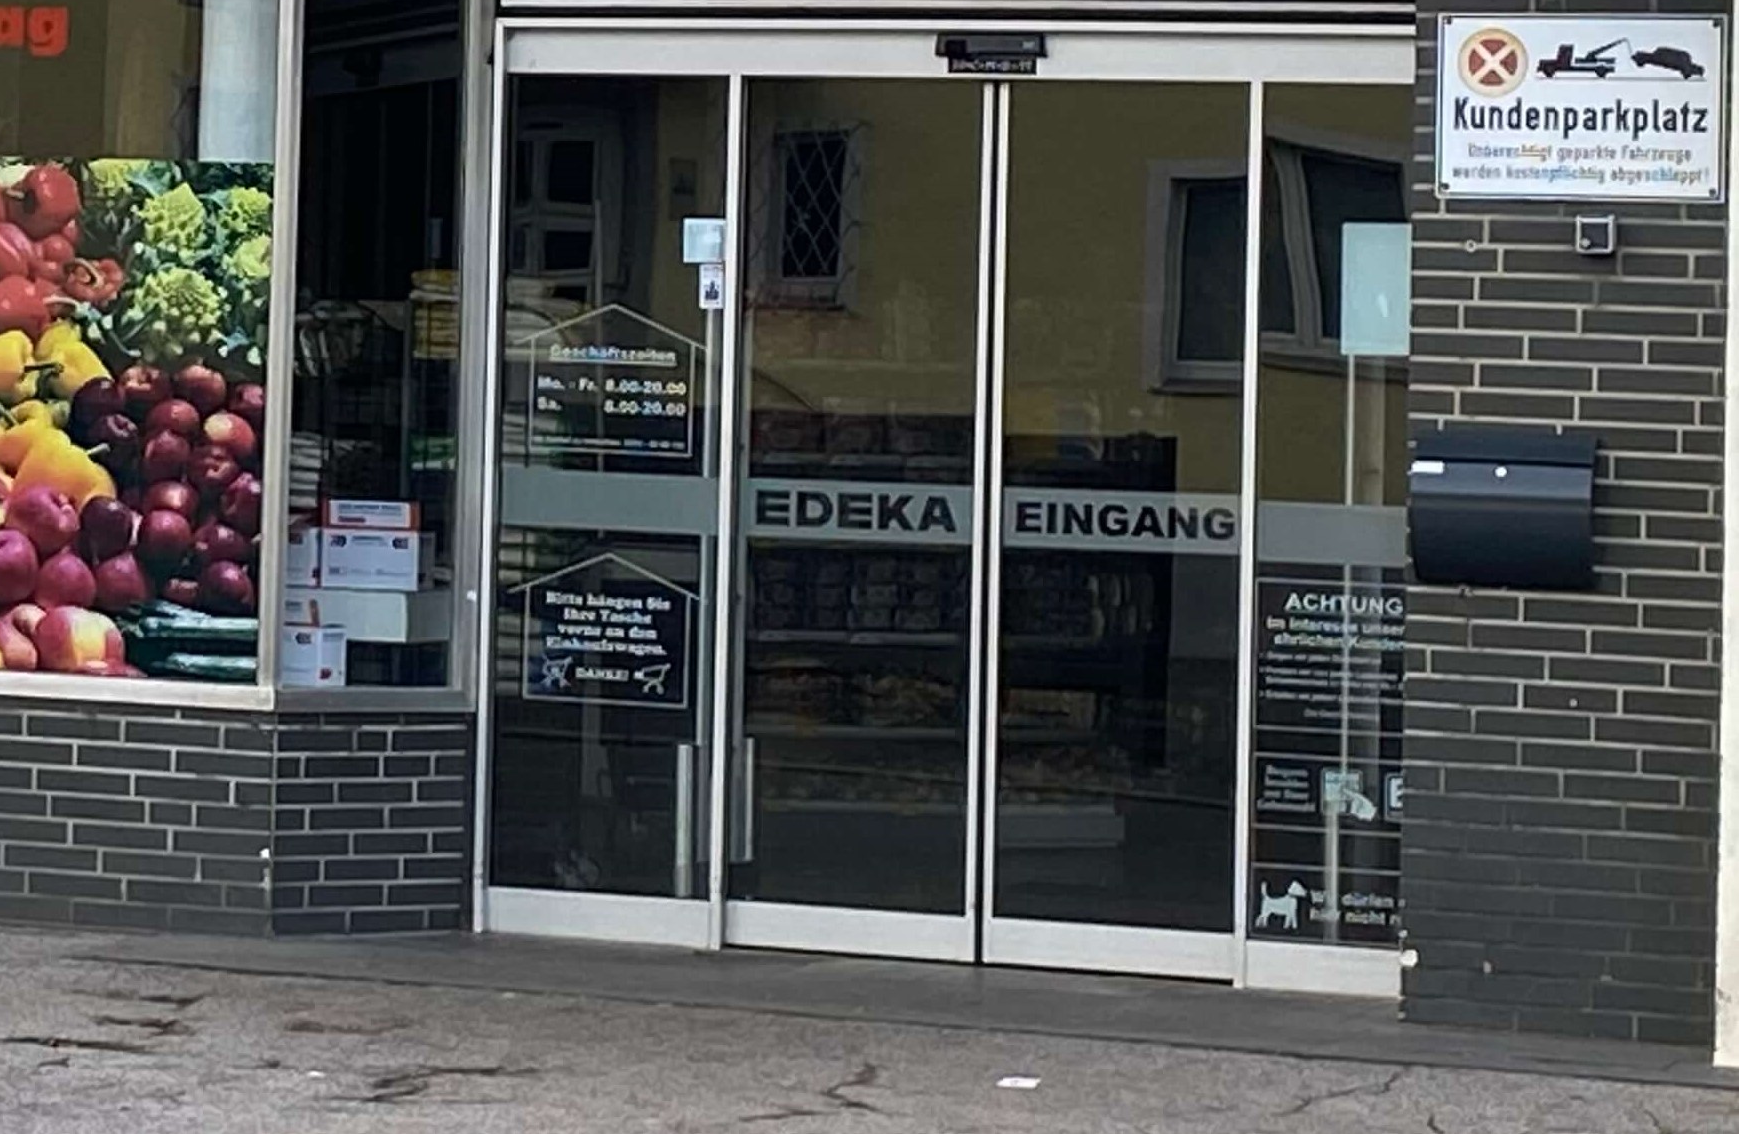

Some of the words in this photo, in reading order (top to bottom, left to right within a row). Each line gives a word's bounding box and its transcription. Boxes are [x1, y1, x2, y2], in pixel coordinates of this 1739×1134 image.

[1453, 97, 1708, 140] Kundenparkplatz
[1556, 143, 1616, 161] geparkte
[1620, 144, 1691, 165] Fahrzeuge
[1452, 166, 1501, 179] werden
[755, 488, 957, 533] EDEKA
[1015, 501, 1235, 541] EINGANG
[1284, 593, 1404, 615] ACHTUNG
